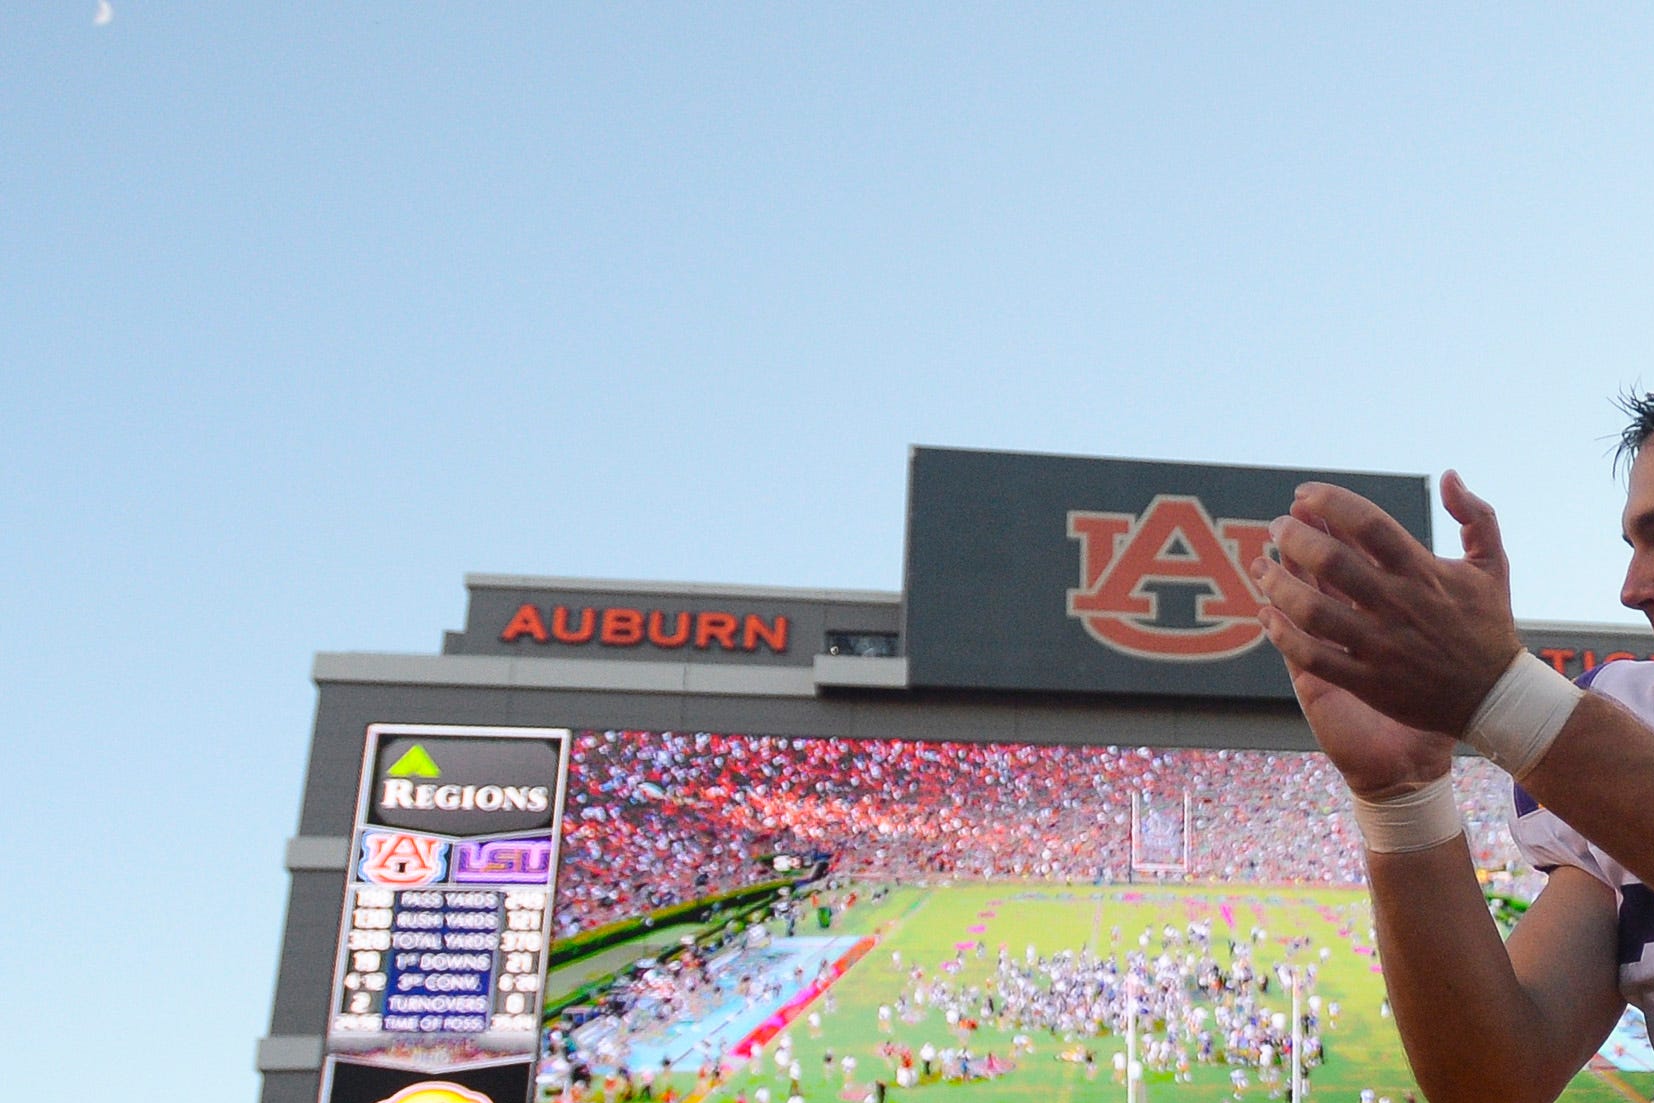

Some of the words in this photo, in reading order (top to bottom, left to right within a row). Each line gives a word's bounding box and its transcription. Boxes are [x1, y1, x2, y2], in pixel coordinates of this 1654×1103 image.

[501, 603, 788, 652] AUBURN
[401, 891, 444, 908] PASS
[445, 892, 498, 909] YARDS
[396, 911, 444, 928] RUSH
[445, 912, 499, 929] YARDS
[393, 931, 441, 950] TOTAL
[444, 932, 499, 950] YARDS
[419, 953, 490, 971] DOWNS
[388, 994, 487, 1013] TURNOVERS
[384, 1015, 419, 1031] TIME
[420, 1015, 442, 1031] OF
